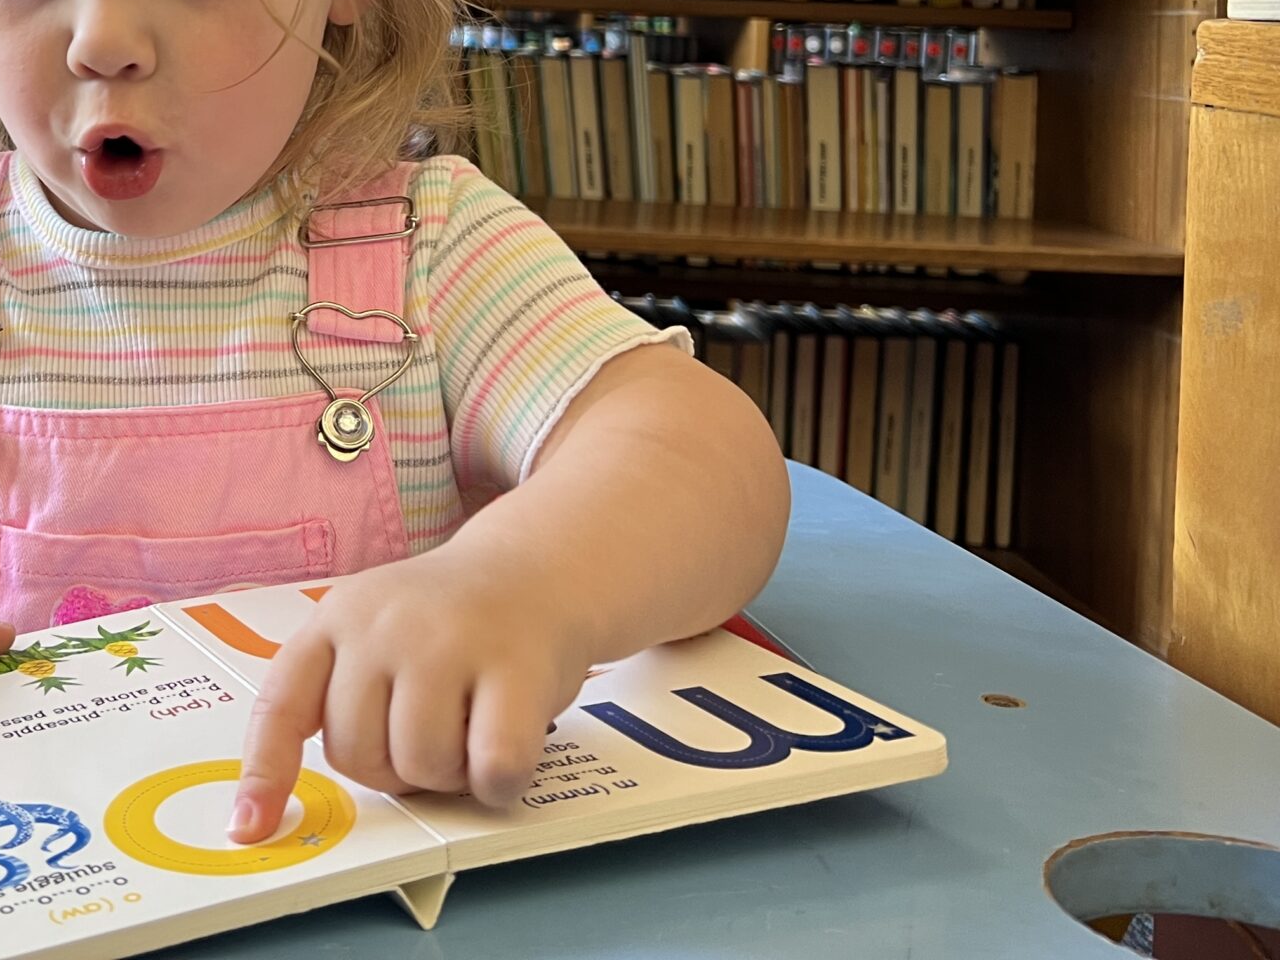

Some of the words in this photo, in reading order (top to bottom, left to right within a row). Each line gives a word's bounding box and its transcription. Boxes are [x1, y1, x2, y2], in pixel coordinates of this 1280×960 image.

[155, 674, 211, 692] fields
[91, 688, 149, 706] along
[218, 692, 235, 702] p
[53, 703, 87, 716] the
[150, 698, 212, 720] (puh)
[0, 710, 47, 728] pass
[579, 672, 916, 770] m
[612, 778, 639, 790] m
[521, 783, 610, 809] (mmm)
[19, 861, 118, 893] squiggle
[123, 892, 143, 903] o
[48, 897, 115, 925] (aw)
